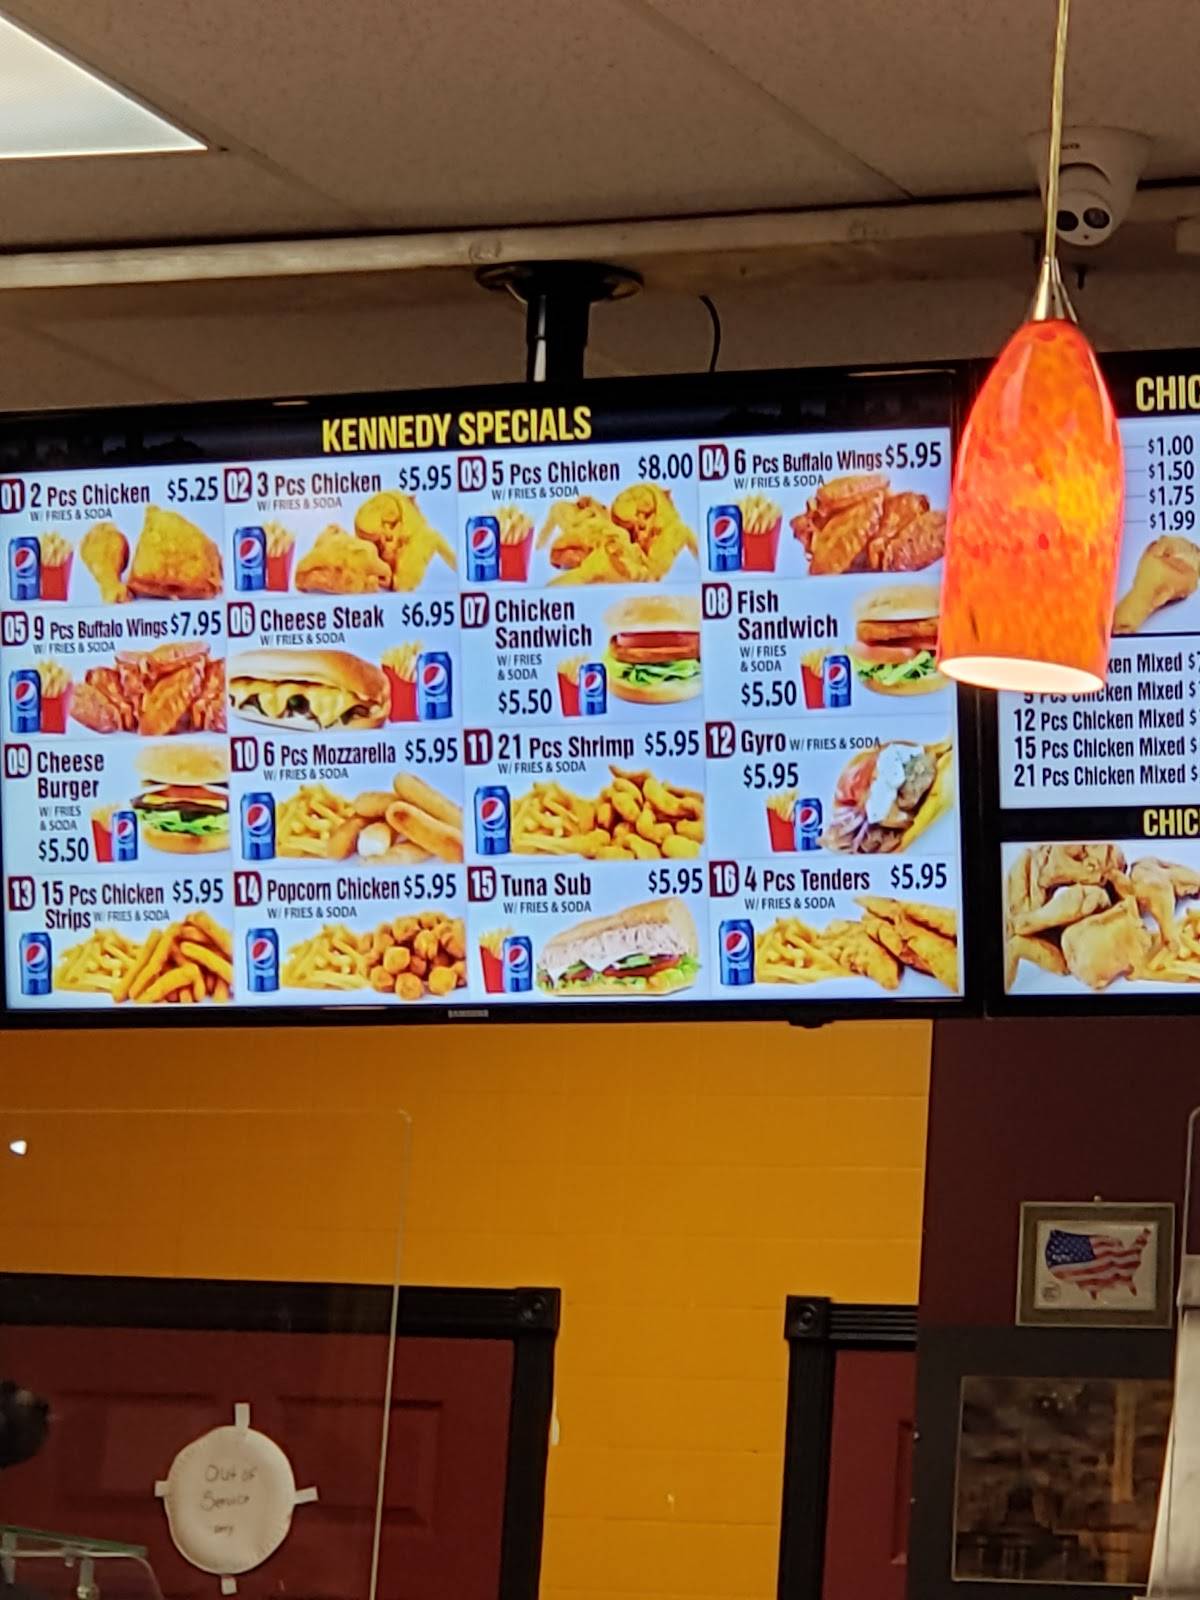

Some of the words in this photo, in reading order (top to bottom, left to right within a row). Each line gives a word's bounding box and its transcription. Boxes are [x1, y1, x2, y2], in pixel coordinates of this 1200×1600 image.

[323, 414, 451, 452] KENNEDY
[458, 406, 592, 445] SPECIALS
[1148, 436, 1193, 456] $1.00
[460, 459, 485, 490] 03
[493, 461, 503, 485] 5
[511, 464, 541, 484] Pcs
[548, 461, 619, 483] Chicken
[638, 453, 693, 480] $8.00
[702, 447, 726, 478] 04
[735, 449, 745, 474] 6
[753, 455, 778, 474] Pcs
[784, 453, 832, 472] Buffalo
[838, 450, 882, 470] Wings
[885, 442, 941, 468] $5.95
[1149, 460, 1194, 481] $1.50
[227, 471, 251, 501] 02
[258, 472, 267, 496] 3
[275, 476, 305, 496] Pcs
[312, 472, 381, 494] Chicken
[399, 465, 451, 490] $5.95
[509, 487, 538, 499] FRIES
[550, 486, 579, 497] SODA
[751, 477, 780, 489] FRIES
[794, 475, 824, 486] SODA
[0, 481, 22, 513] 01
[31, 483, 41, 508] 2
[48, 487, 77, 506] Pcs
[83, 483, 149, 505] Chicken
[167, 477, 218, 503] $5.25
[274, 499, 301, 510] FRIES
[313, 497, 341, 509] SODA
[1149, 485, 1194, 506] $1.75
[46, 511, 72, 521] FRIES
[84, 509, 112, 520] SODA
[1150, 511, 1195, 531] $1.99
[464, 596, 486, 625] 07
[495, 599, 574, 623] Chicken
[706, 586, 729, 616] 08
[738, 590, 778, 614] Fish
[4, 615, 27, 644] 05
[34, 616, 43, 640] 9
[51, 623, 73, 640] Pcs
[79, 619, 122, 638] Buffalo
[127, 618, 168, 638] Wings
[171, 611, 221, 636] $7.95
[230, 606, 253, 635] 06
[261, 609, 326, 632] Cheese
[333, 605, 384, 629] Steak
[401, 602, 454, 627] $6.95
[738, 614, 838, 640] Sandwich
[50, 643, 76, 654] FRIES
[88, 641, 115, 652] SODA
[277, 634, 303, 645] FRIES
[316, 632, 345, 644] SODA
[495, 624, 592, 649] Sandwich
[514, 654, 542, 665] FRIES
[757, 645, 786, 656] FRIES
[508, 668, 537, 680] SODA
[751, 660, 782, 672] SODA
[1137, 653, 1182, 674] Mixed
[498, 688, 552, 714] $5.50
[742, 680, 797, 707] $5.50
[1138, 680, 1183, 700] Mixed
[1014, 709, 1035, 732] 12
[1041, 712, 1068, 731] Pcs
[1073, 710, 1133, 729] Chicken
[1139, 708, 1184, 728] Mixed
[468, 733, 491, 763] 11
[498, 734, 521, 759] 21
[530, 738, 562, 758] Pcs
[569, 735, 634, 759] Shrimp
[645, 730, 699, 756] $5.95
[710, 725, 733, 756] 12
[741, 730, 786, 756] Gyro
[807, 738, 836, 750] FRIES
[850, 737, 881, 748] SODA
[1014, 736, 1036, 759] 15
[1042, 740, 1069, 759] Pcs
[1074, 738, 1133, 758] Chicken
[1140, 736, 1185, 756] Mixed
[7, 748, 27, 775] 09
[38, 751, 104, 773] Cheese
[234, 741, 257, 770] 10
[264, 741, 274, 766] 6
[282, 746, 308, 766] Pcs
[314, 743, 396, 764] Mozzarella
[405, 738, 457, 763] $5.95
[280, 769, 307, 781] FRIES
[320, 768, 349, 779] SODA
[515, 763, 543, 774] FRIES
[556, 761, 586, 773] SODA
[744, 763, 798, 788] $5.95
[1014, 764, 1034, 787] 21
[1043, 768, 1069, 786] Pcs
[1075, 766, 1134, 785] Chicken
[1140, 764, 1185, 784] Mixed
[38, 777, 99, 801] Burger
[55, 806, 81, 816] FRIES
[49, 820, 77, 831] SODA
[39, 837, 88, 862] $5.50
[238, 874, 261, 904] 14
[268, 879, 331, 904] Popcorn
[337, 877, 399, 900] Chicken
[404, 873, 456, 899] $5.95
[471, 870, 494, 900] 15
[501, 874, 546, 897] Tuna
[555, 873, 591, 895] Sub
[648, 868, 703, 894] $5.95
[713, 865, 737, 896] 16
[745, 866, 756, 892] 4
[764, 871, 795, 891] Pcs
[801, 868, 869, 890] Tenders
[890, 863, 947, 889] $5.95
[11, 880, 33, 909] 13
[42, 882, 63, 906] 15
[70, 886, 96, 905] Pcs
[102, 884, 163, 905] Chicken
[173, 879, 223, 904] $5.95
[762, 898, 791, 909] FRIES
[804, 897, 835, 909] SODA
[285, 907, 313, 919] FRIES
[326, 906, 357, 917] SODA
[520, 902, 548, 913] FRIES
[562, 901, 591, 912] SODA
[45, 909, 91, 931] Strips
[108, 911, 132, 921] FRIES
[143, 910, 170, 921] SODA
[205, 1464, 236, 1482] Out
